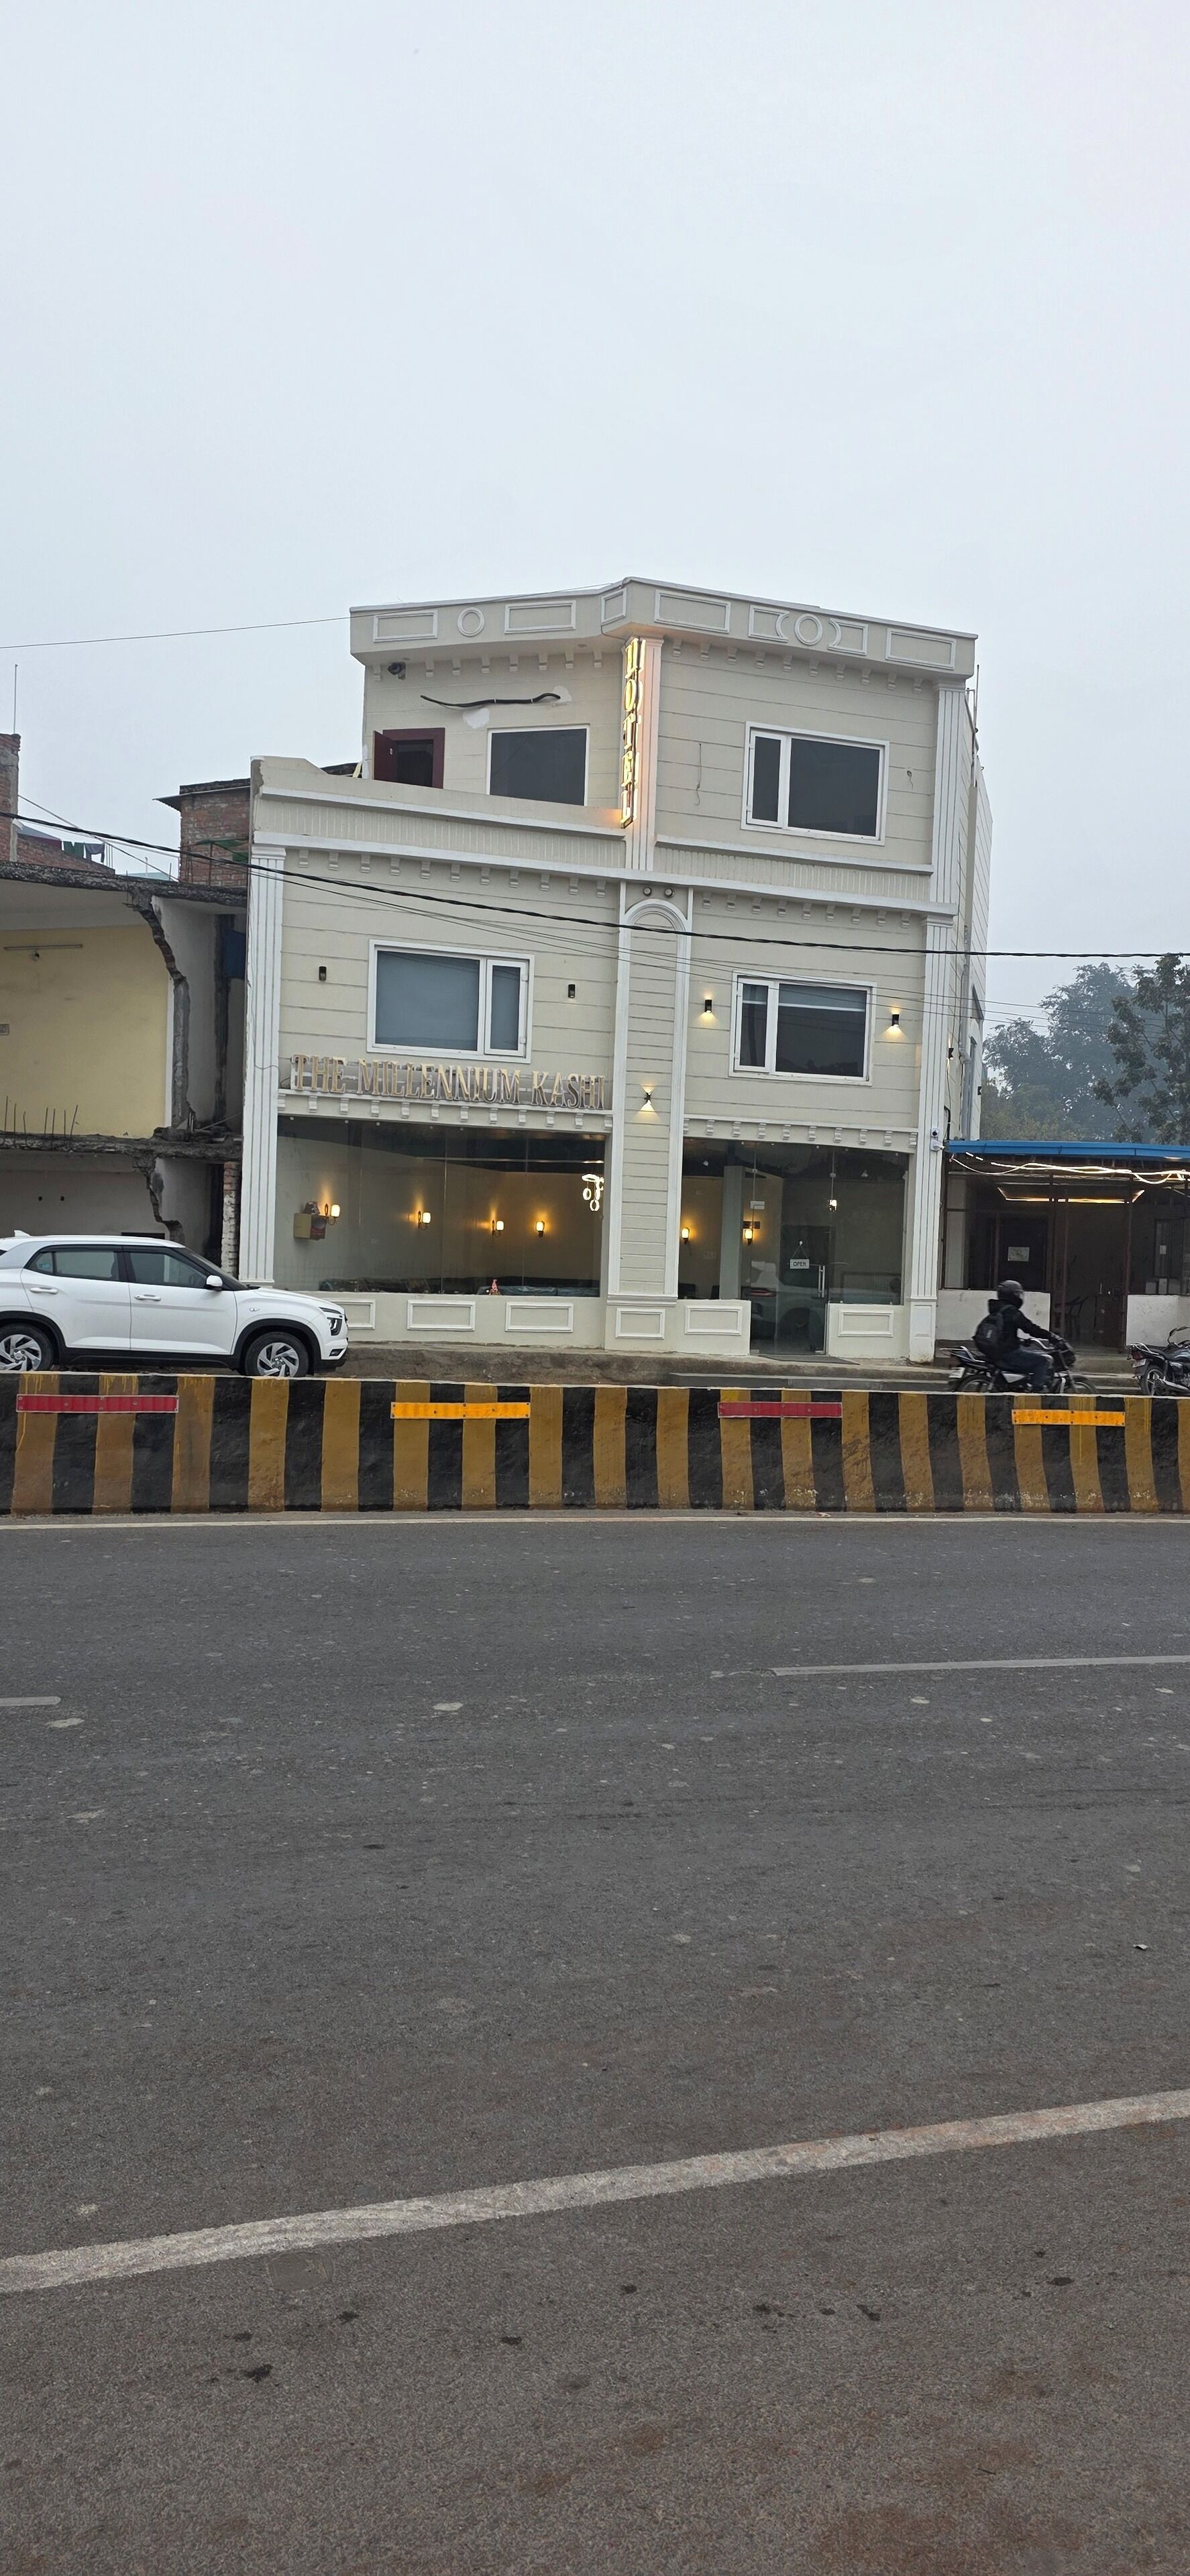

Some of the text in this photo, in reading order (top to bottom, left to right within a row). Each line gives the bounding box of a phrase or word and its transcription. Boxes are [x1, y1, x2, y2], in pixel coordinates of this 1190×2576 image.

[620, 637, 639, 828] HOTEL
[291, 1054, 605, 1110] THE MILLENNIUM KASHI
